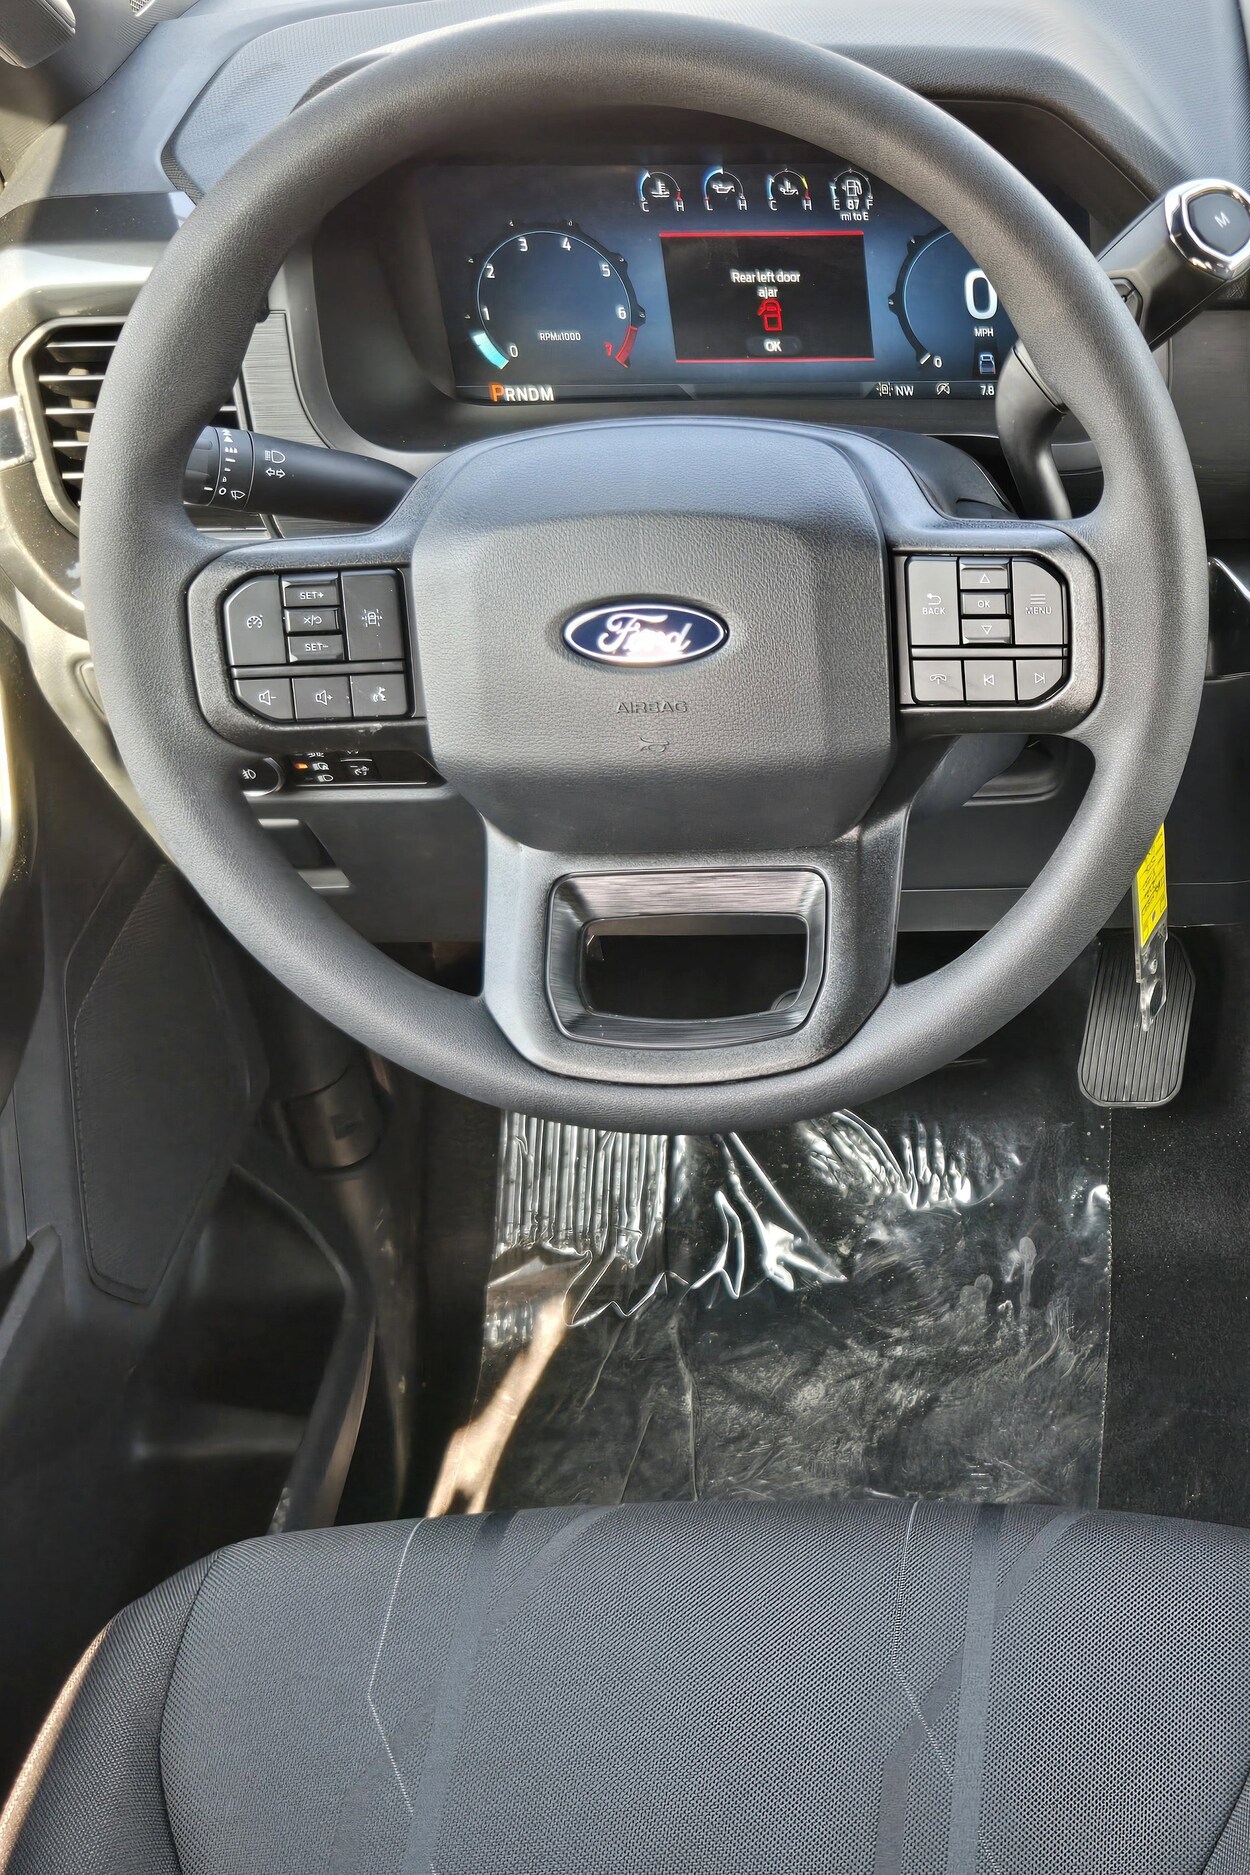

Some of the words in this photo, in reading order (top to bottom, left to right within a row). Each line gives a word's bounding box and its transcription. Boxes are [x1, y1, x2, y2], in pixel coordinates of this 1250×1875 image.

[642, 202, 649, 212] C
[676, 202, 684, 212] H
[707, 201, 713, 211] L
[740, 201, 748, 211] H
[770, 201, 778, 211] C
[804, 201, 812, 211] H
[833, 199, 840, 210] E
[847, 199, 859, 210] 87
[866, 199, 873, 210] F
[841, 213, 852, 221] mi
[853, 212, 862, 221] to
[863, 211, 869, 221] E
[1214, 211, 1231, 229] M
[518, 237, 528, 252] 3
[562, 238, 571, 251] 4
[486, 264, 496, 279] 2
[602, 264, 611, 277] 5
[732, 271, 756, 283] Rear
[757, 270, 776, 283] left
[777, 270, 800, 283] door
[758, 287, 778, 299] ajar
[965, 269, 998, 320] 0
[483, 306, 490, 321] 1
[618, 306, 627, 320] 6
[539, 332, 581, 341] RPMx1000
[974, 328, 994, 337] MPH
[509, 344, 519, 358] 0
[605, 344, 613, 357] 7
[765, 340, 782, 352] OK
[934, 356, 943, 368] 0
[896, 385, 914, 396] NW
[981, 385, 995, 396] 7.8
[300, 591, 324, 600] SET+
[977, 600, 991, 608] OK
[922, 607, 946, 615] BACK
[1025, 607, 1052, 615] MENU
[617, 701, 688, 714] AIRBAG
